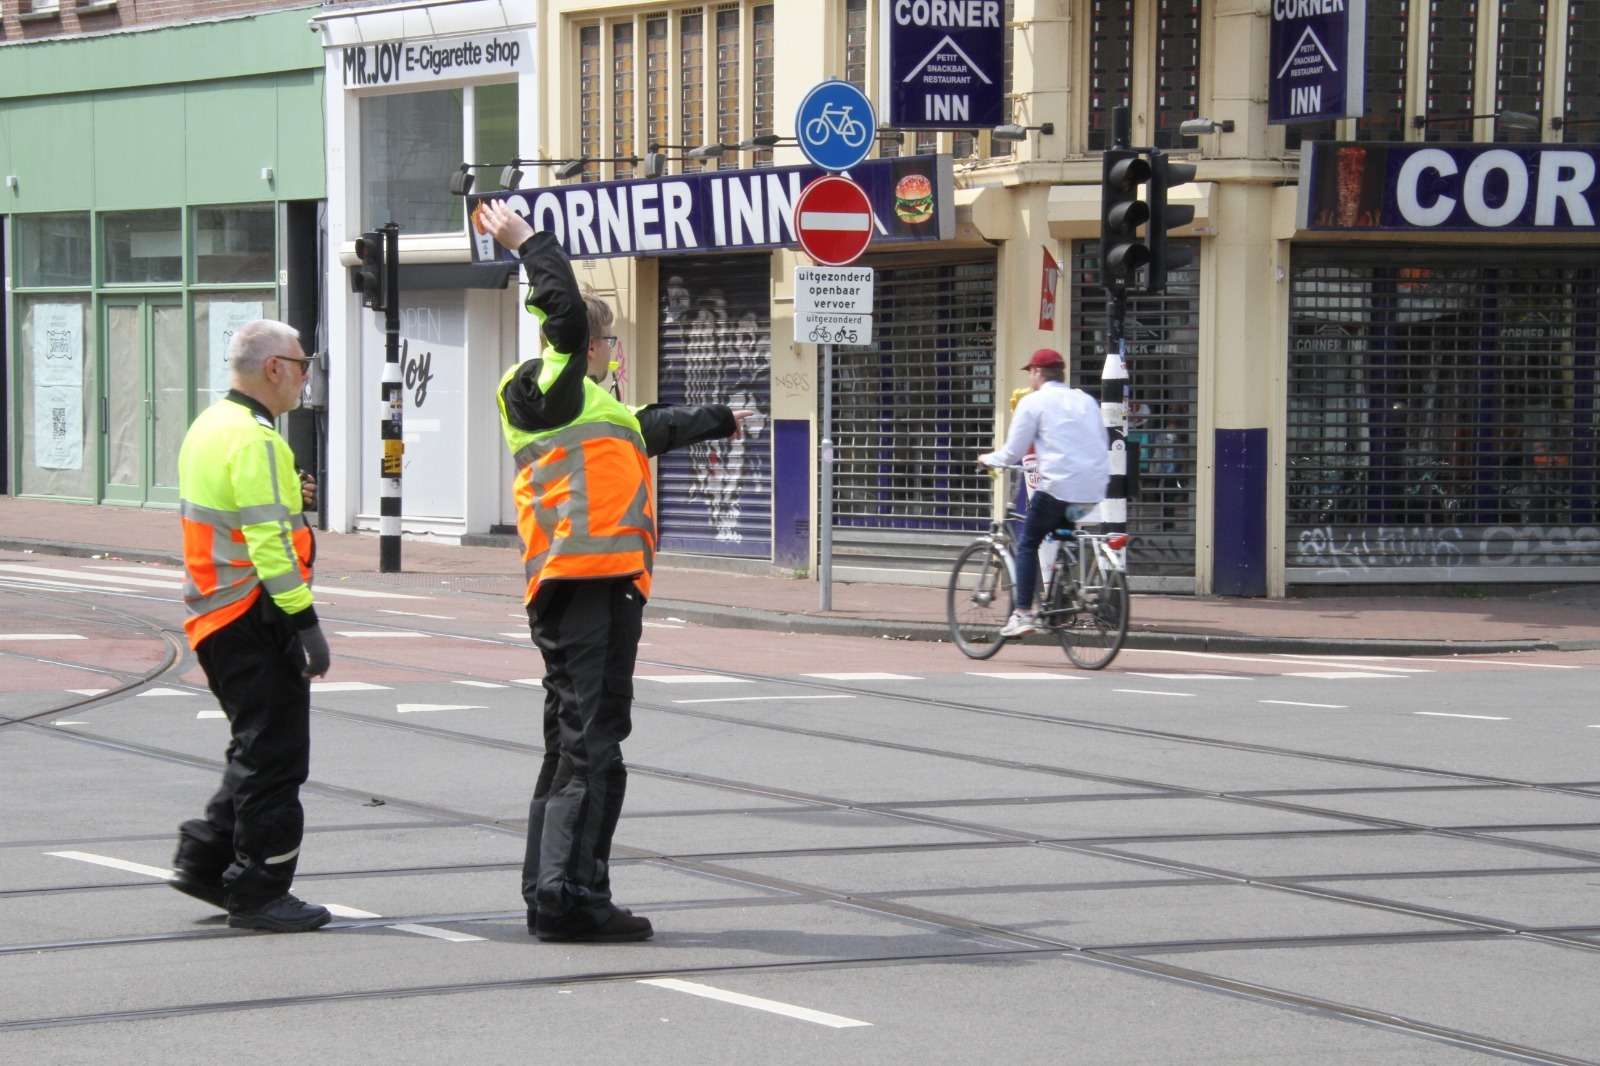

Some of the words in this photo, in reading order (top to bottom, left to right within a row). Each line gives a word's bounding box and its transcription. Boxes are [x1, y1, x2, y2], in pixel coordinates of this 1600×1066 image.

[895, 0, 1000, 27] CORNER
[1300, 44, 1316, 53] PETIT
[343, 42, 402, 85] MR.JOY
[405, 45, 482, 75] E-Cigarette
[485, 37, 520, 66] shop
[1294, 55, 1322, 66] SNACKBAR
[927, 65, 967, 73] SNACKBAR
[1290, 66, 1324, 77] RESTAURANT
[923, 76, 971, 84] RESTAURANT
[1290, 84, 1321, 116] INN
[925, 94, 969, 121] INN
[1396, 148, 1596, 227] COR
[711, 171, 800, 246] INN
[799, 271, 871, 284] uitgezonderd
[809, 286, 860, 296] openbaar
[814, 300, 856, 309] vervoer
[806, 314, 862, 325] uitgezonderd
[1296, 339, 1342, 351] CORNER
